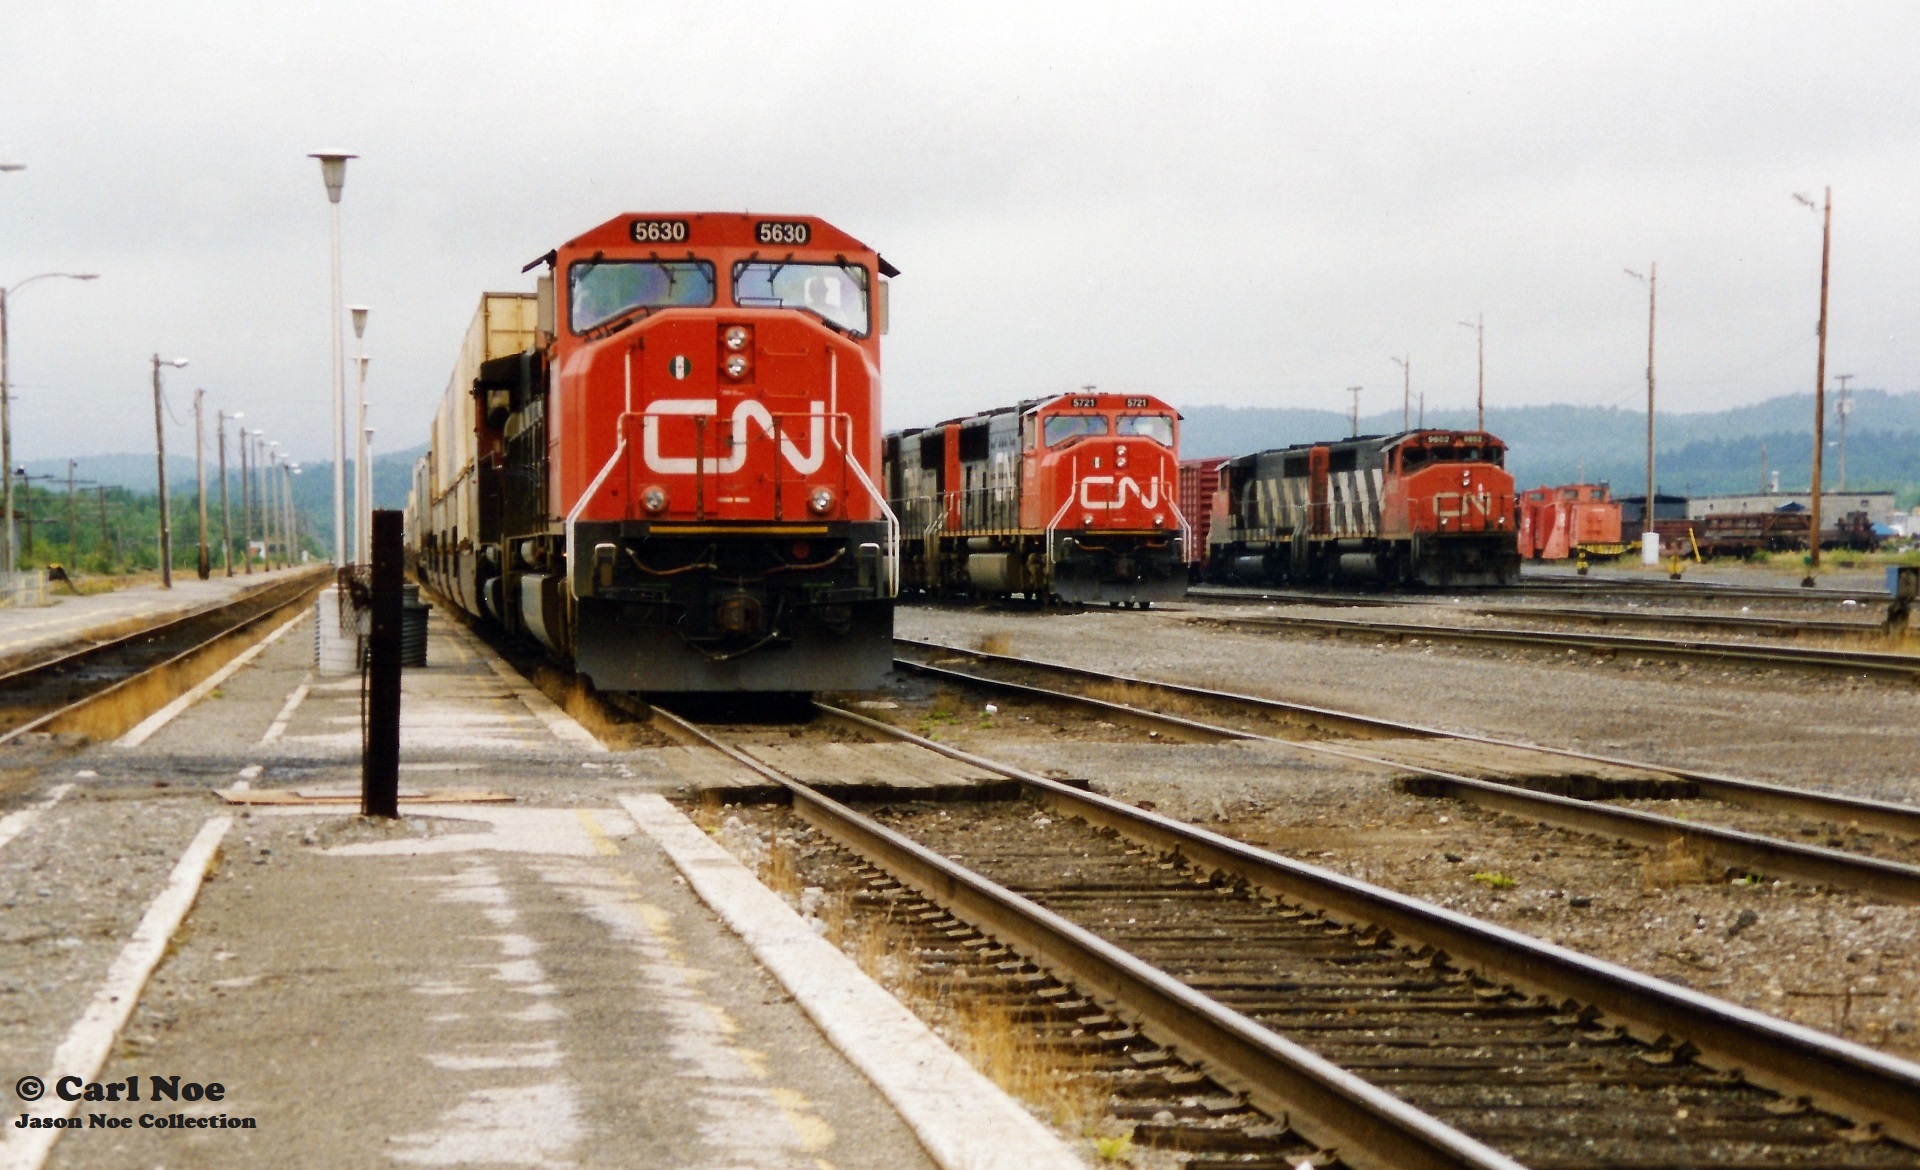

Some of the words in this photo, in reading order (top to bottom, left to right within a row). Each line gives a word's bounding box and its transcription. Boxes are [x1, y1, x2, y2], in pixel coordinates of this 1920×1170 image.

[635, 222, 685, 241] 5630
[760, 223, 807, 243] 5630
[1073, 398, 1095, 407] 5721
[1127, 398, 1146, 407] 5721
[643, 399, 825, 474] CN
[1080, 476, 1158, 509] CN
[1433, 491, 1492, 517] CN
